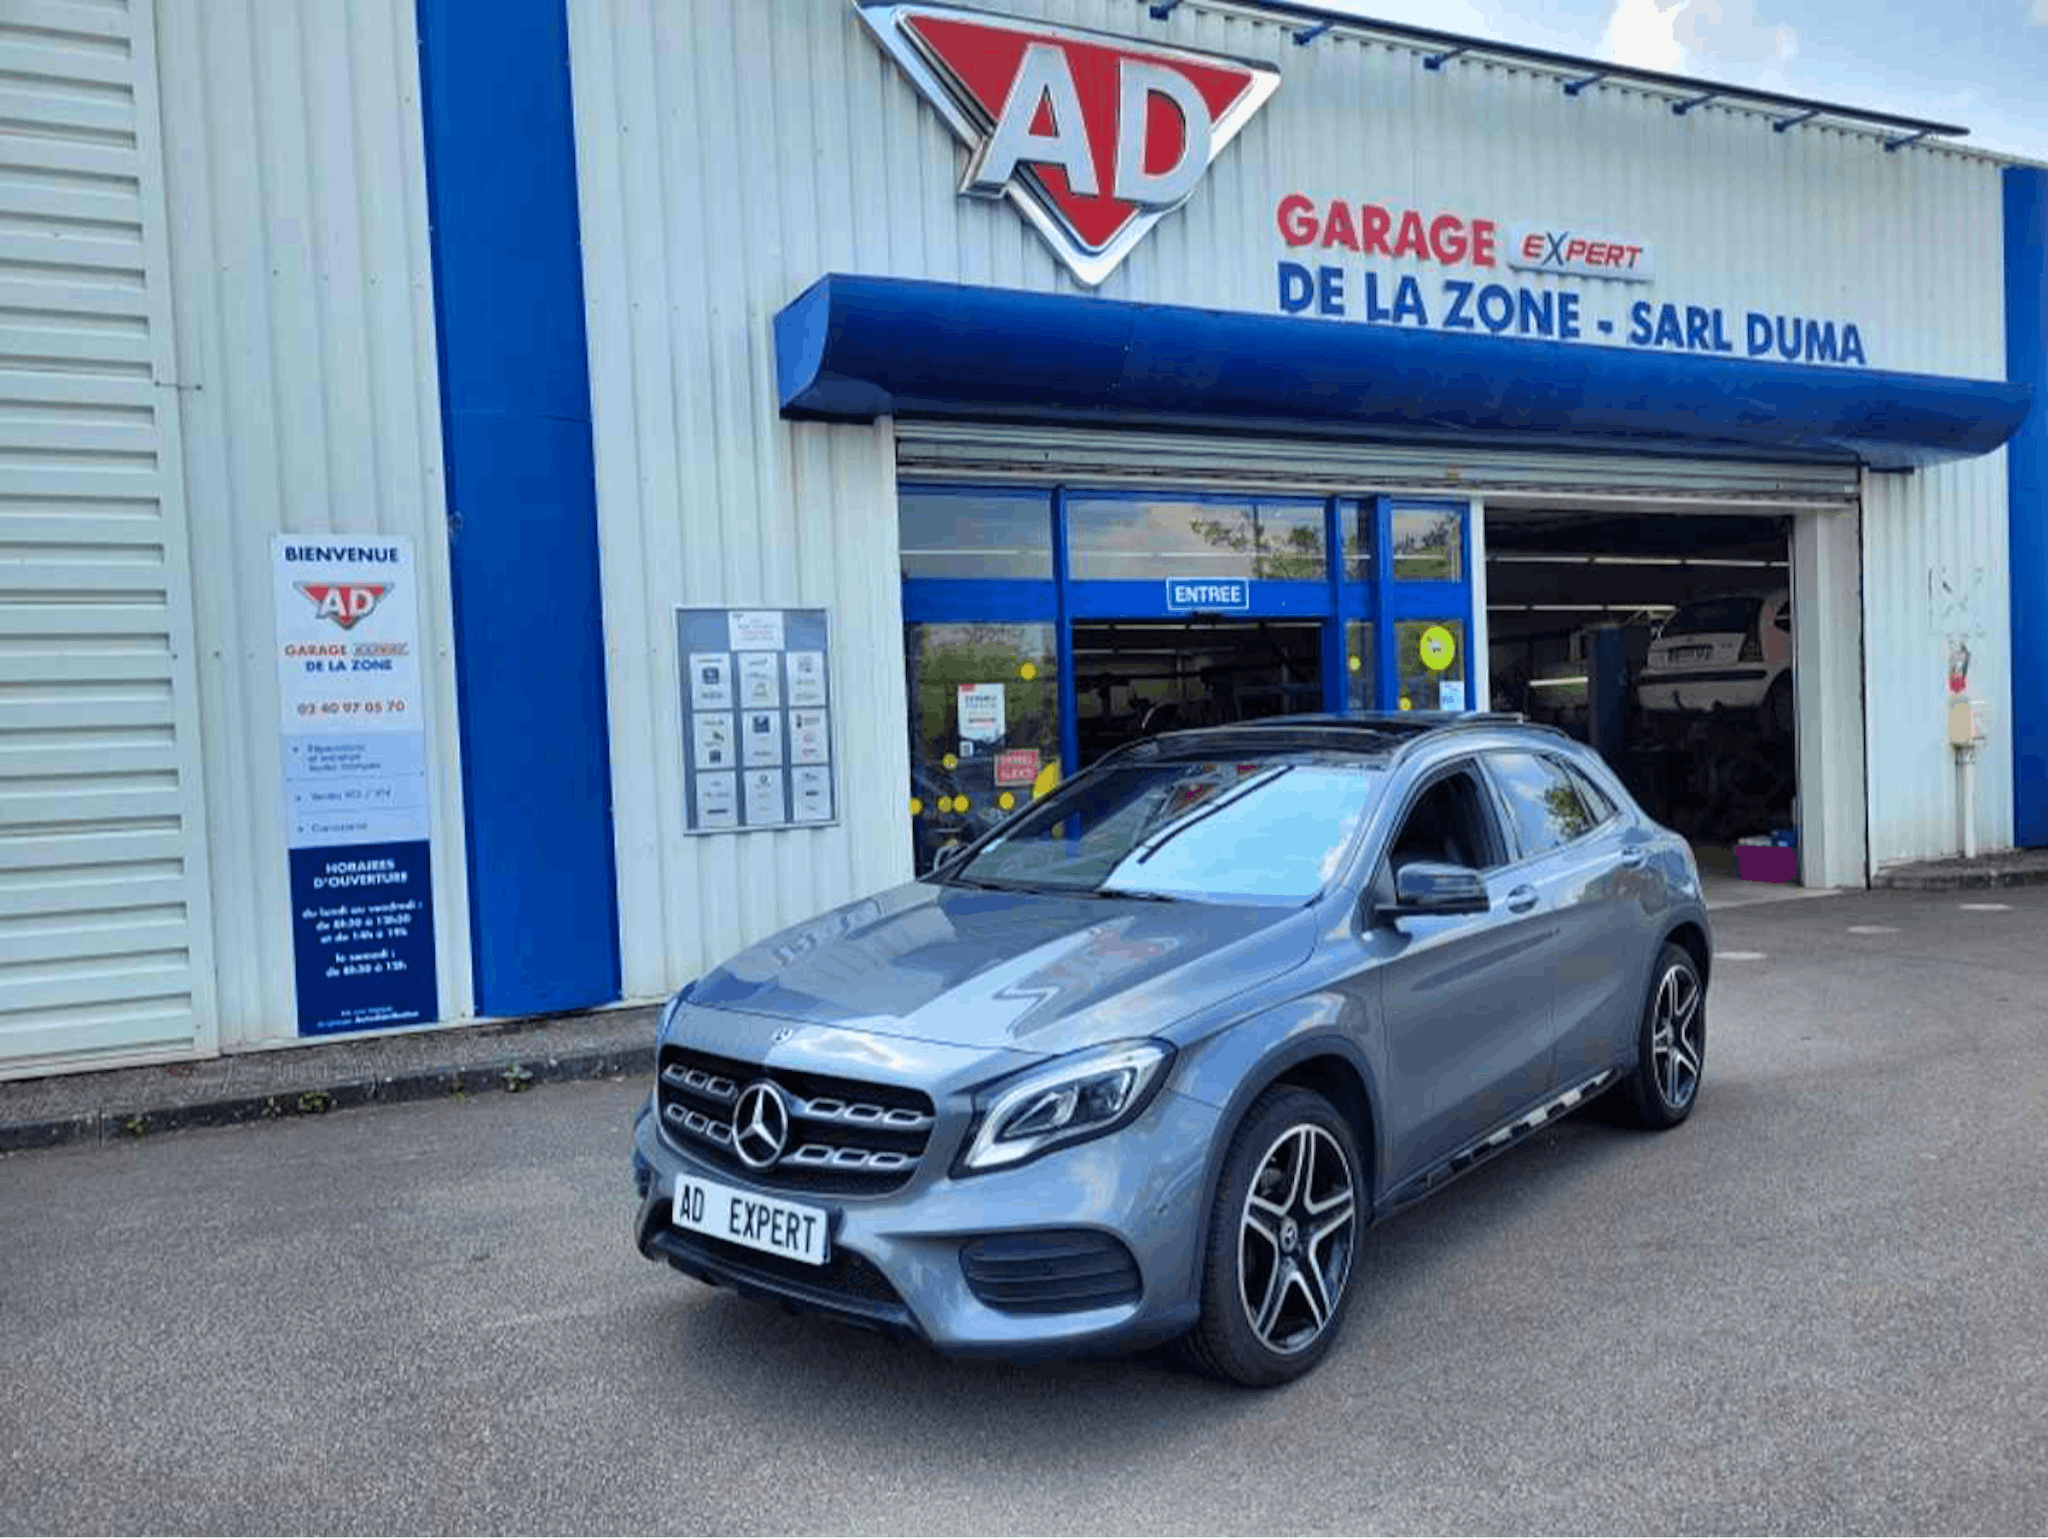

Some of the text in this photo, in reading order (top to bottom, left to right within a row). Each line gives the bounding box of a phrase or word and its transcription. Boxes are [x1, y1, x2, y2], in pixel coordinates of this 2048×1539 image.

[969, 42, 1212, 204] AD
[1276, 192, 1497, 268] GARAGE
[1277, 260, 1345, 315] DE
[1364, 270, 1428, 327] LA
[1442, 279, 1581, 339] ZONE
[1629, 301, 1733, 353] SARL
[1745, 312, 1867, 366] DUMA
[285, 546, 398, 563] BIENVENUE
[316, 587, 375, 619] AD
[1175, 585, 1242, 603] ENTREE
[284, 644, 347, 657] GARAGE
[305, 659, 393, 672] DE LA ZONE
[325, 858, 395, 874] HORAIRES
[313, 870, 408, 889] D'OUVERTURE
[680, 1184, 818, 1254] AD EXPERT
